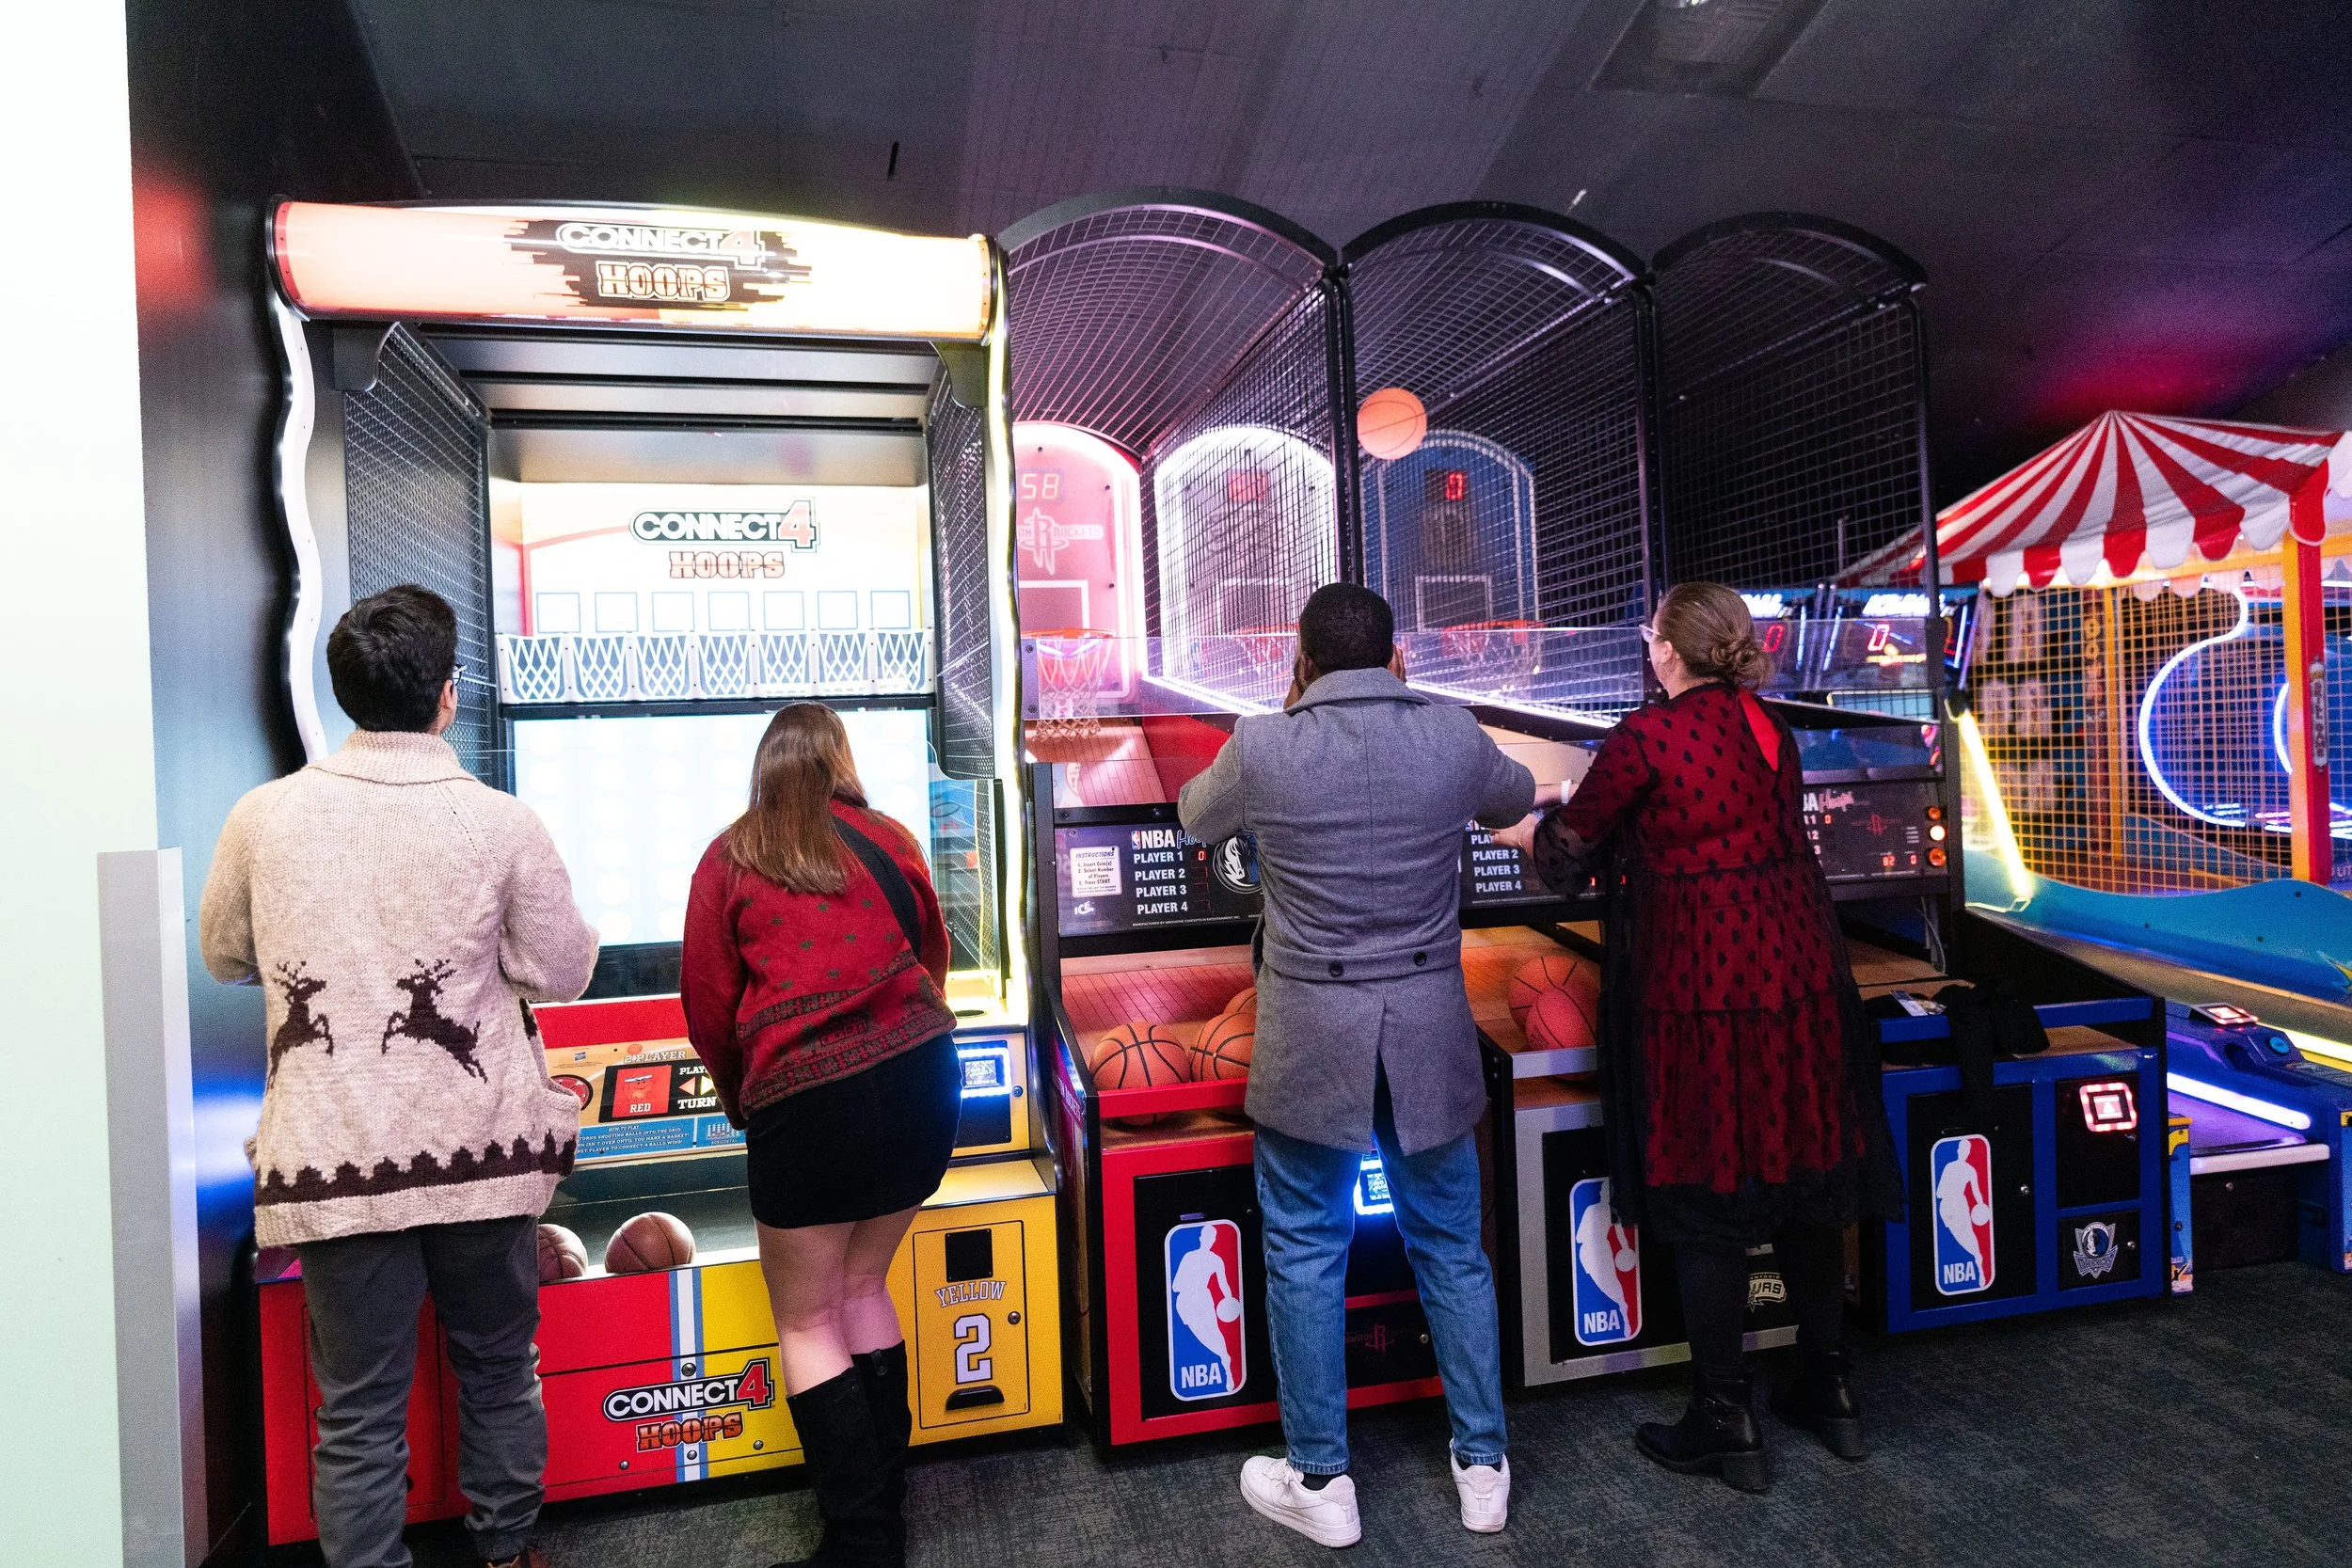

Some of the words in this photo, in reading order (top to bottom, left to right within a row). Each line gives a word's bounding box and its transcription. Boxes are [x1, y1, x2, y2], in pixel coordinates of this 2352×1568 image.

[598, 263, 728, 299] HOOPS
[1022, 473, 1059, 499] 58
[1445, 472, 1465, 500] 0
[1053, 528, 1101, 538] ROCKETS
[669, 551, 785, 578] HOOPS
[1141, 830, 1176, 848] NBA
[1134, 851, 1174, 864] PLAYER
[1177, 850, 1184, 862] 1
[1198, 850, 1205, 861] 0
[1472, 849, 1510, 862] PLAYER
[1511, 848, 1518, 859] 2
[1135, 868, 1176, 881] PLAYER
[1178, 868, 1185, 879] 2
[1474, 865, 1511, 877] PLAYER
[1513, 864, 1519, 875] 3
[1136, 885, 1177, 898] PLAYER
[1180, 884, 1187, 895] 3
[1475, 881, 1513, 893] PLAYER
[1515, 880, 1522, 891] 4
[1074, 901, 1094, 915] ICE
[1136, 902, 1178, 915] PLAYER
[1181, 901, 1188, 911] 4
[629, 1103, 651, 1113] RED
[677, 1097, 717, 1109] TURN
[1943, 1260, 1976, 1286] NBA
[935, 1281, 1007, 1307] YELLOW
[1583, 1309, 1621, 1335] NBA
[954, 1313, 993, 1385] 2
[1181, 1362, 1222, 1388] NBA
[637, 1411, 745, 1452] HOOPS
